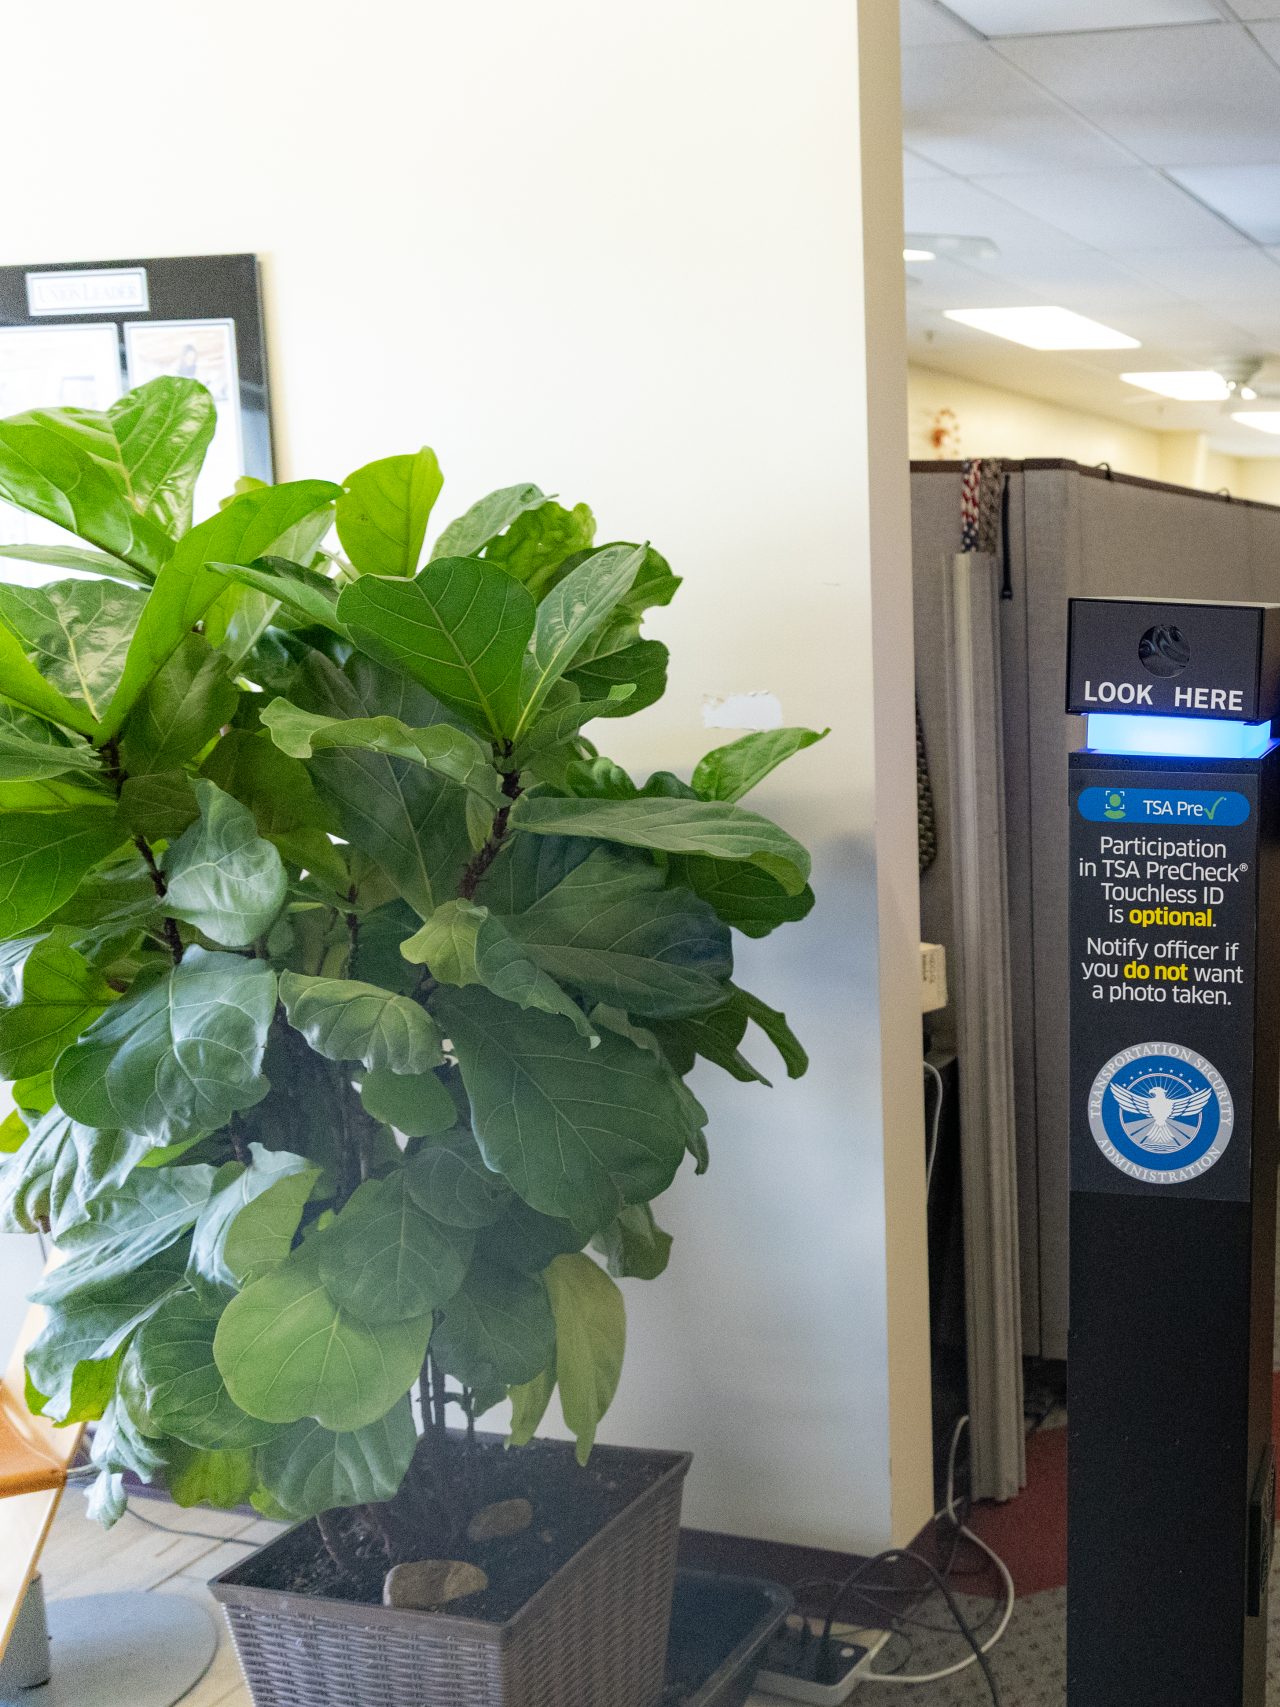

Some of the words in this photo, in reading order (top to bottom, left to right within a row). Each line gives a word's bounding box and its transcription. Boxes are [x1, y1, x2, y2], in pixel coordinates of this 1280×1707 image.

[1084, 680, 1153, 705] LOOK
[1174, 686, 1243, 711] HERE
[1143, 799, 1173, 816] TSA
[1177, 801, 1203, 817] Pre
[1100, 836, 1227, 859] Participation
[1079, 858, 1097, 877] in
[1102, 859, 1140, 879] TSA
[1101, 882, 1197, 904] Touchless
[1203, 886, 1224, 905] ID
[1108, 904, 1124, 923] is
[1129, 907, 1216, 927] optional.
[1087, 937, 1148, 960] Notify
[1154, 940, 1219, 960] officer
[1225, 942, 1239, 961] if
[1081, 962, 1118, 980] you
[1124, 961, 1150, 979] do
[1155, 963, 1188, 981] not
[1194, 966, 1244, 984] want
[1092, 985, 1103, 999] a
[1109, 982, 1167, 1003] photo
[1172, 985, 1231, 1006] taken.
[1090, 1044, 1192, 1119] TRANSPORTATION
[1193, 1057, 1233, 1126] SECURITY
[1098, 1139, 1221, 1183] ADMINISTRATION
